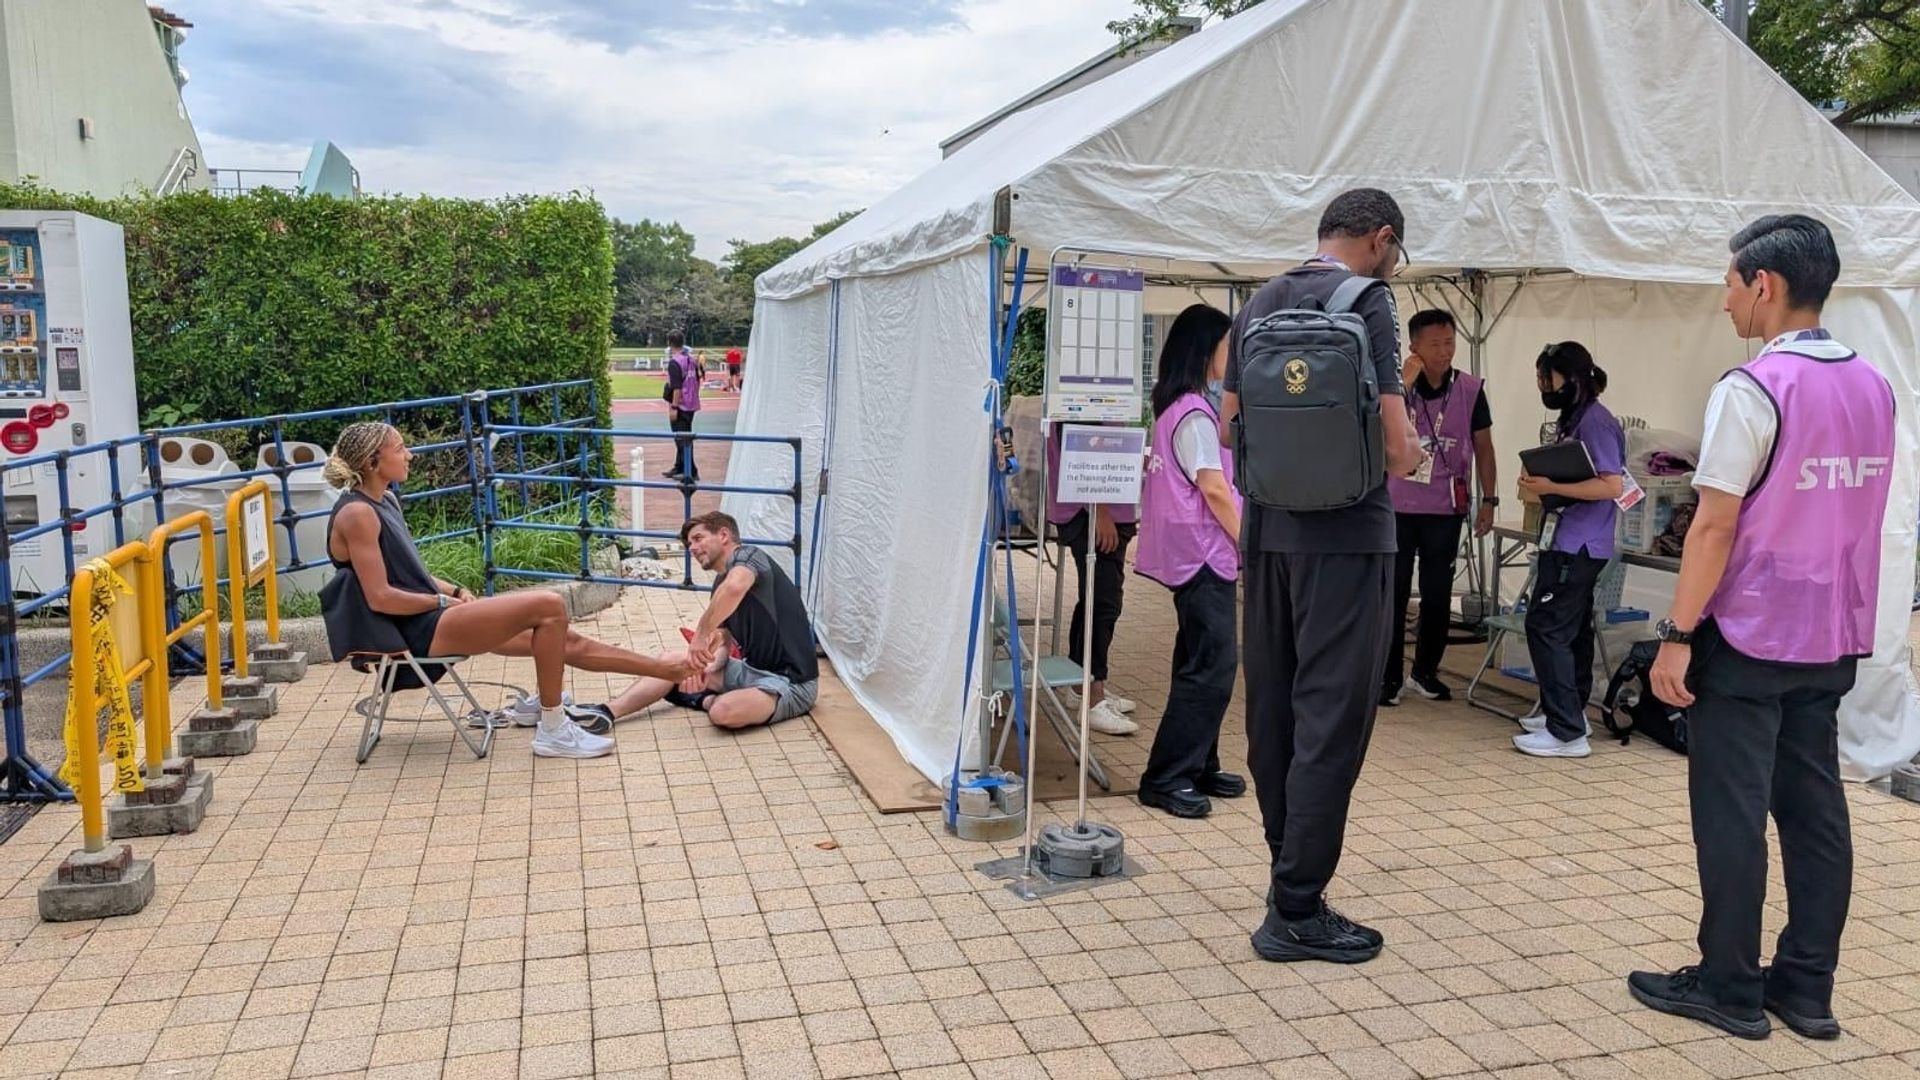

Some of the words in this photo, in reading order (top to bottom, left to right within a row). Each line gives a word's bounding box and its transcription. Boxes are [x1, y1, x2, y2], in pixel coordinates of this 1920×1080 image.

[1067, 462, 1099, 471] Facilities
[1100, 463, 1119, 471] other
[1119, 464, 1135, 472] than
[1079, 474, 1107, 484] Training
[1107, 475, 1123, 483] Area
[1076, 485, 1089, 494] not
